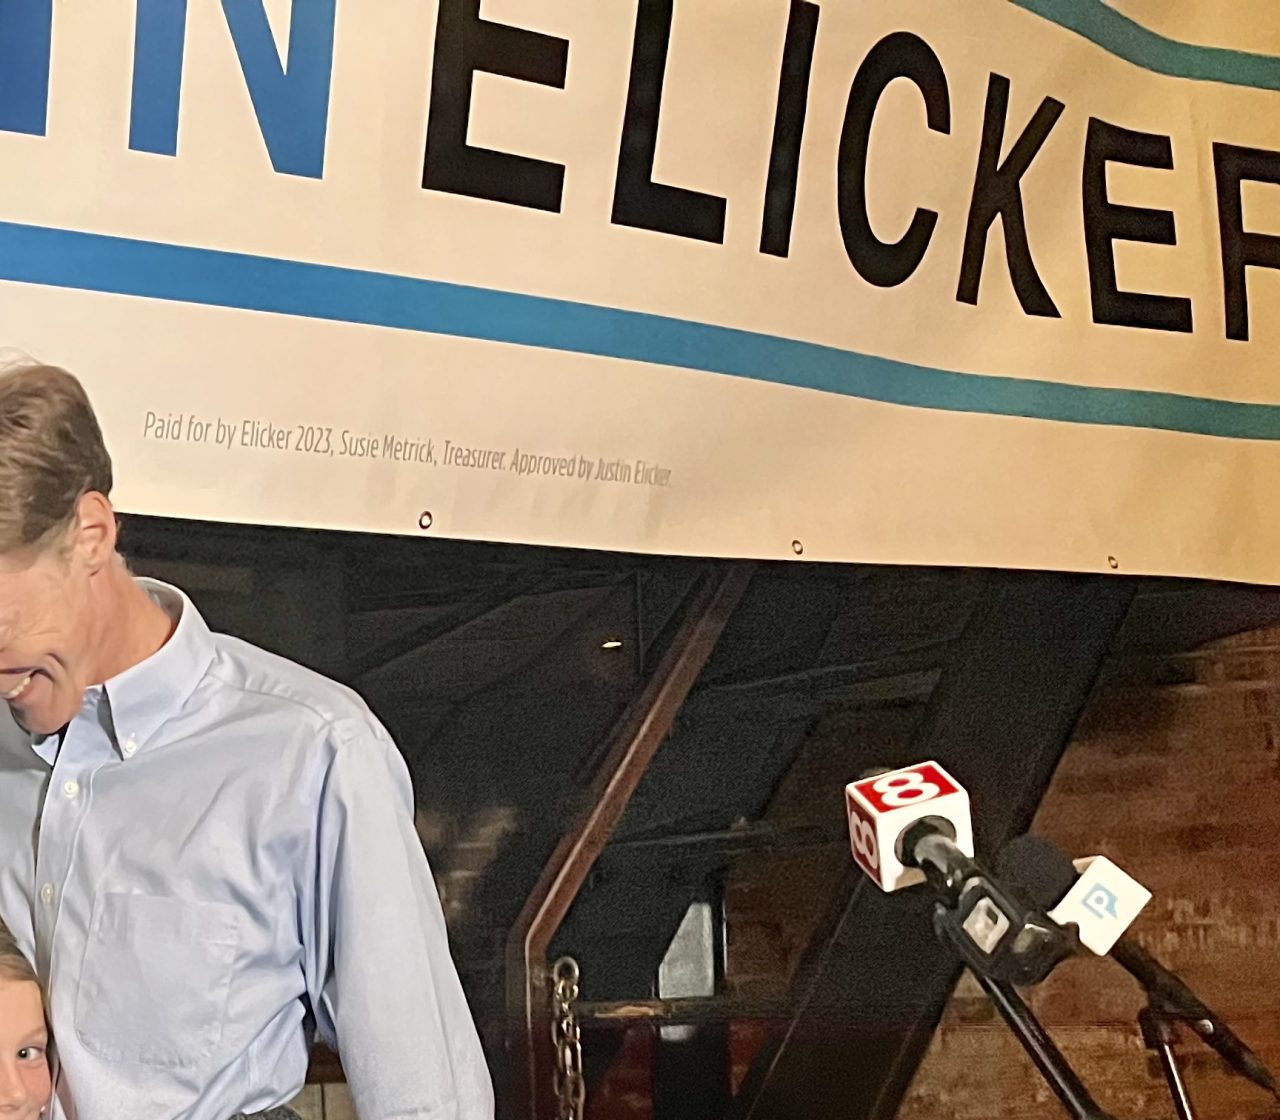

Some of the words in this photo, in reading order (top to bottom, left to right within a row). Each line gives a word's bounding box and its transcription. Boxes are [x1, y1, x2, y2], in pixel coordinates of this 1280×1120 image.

[143, 411, 184, 440] Paid
[186, 415, 213, 443] for
[215, 417, 237, 449] by
[240, 419, 293, 450] Elicker
[295, 425, 335, 457] 2023,
[339, 430, 380, 459] Susie
[381, 434, 438, 467] Metrick,
[443, 440, 507, 471] Treasurer.
[509, 448, 577, 477] Approved
[577, 455, 596, 481] by
[594, 457, 632, 484] Justin
[873, 771, 940, 806] 8
[850, 811, 878, 868] 8
